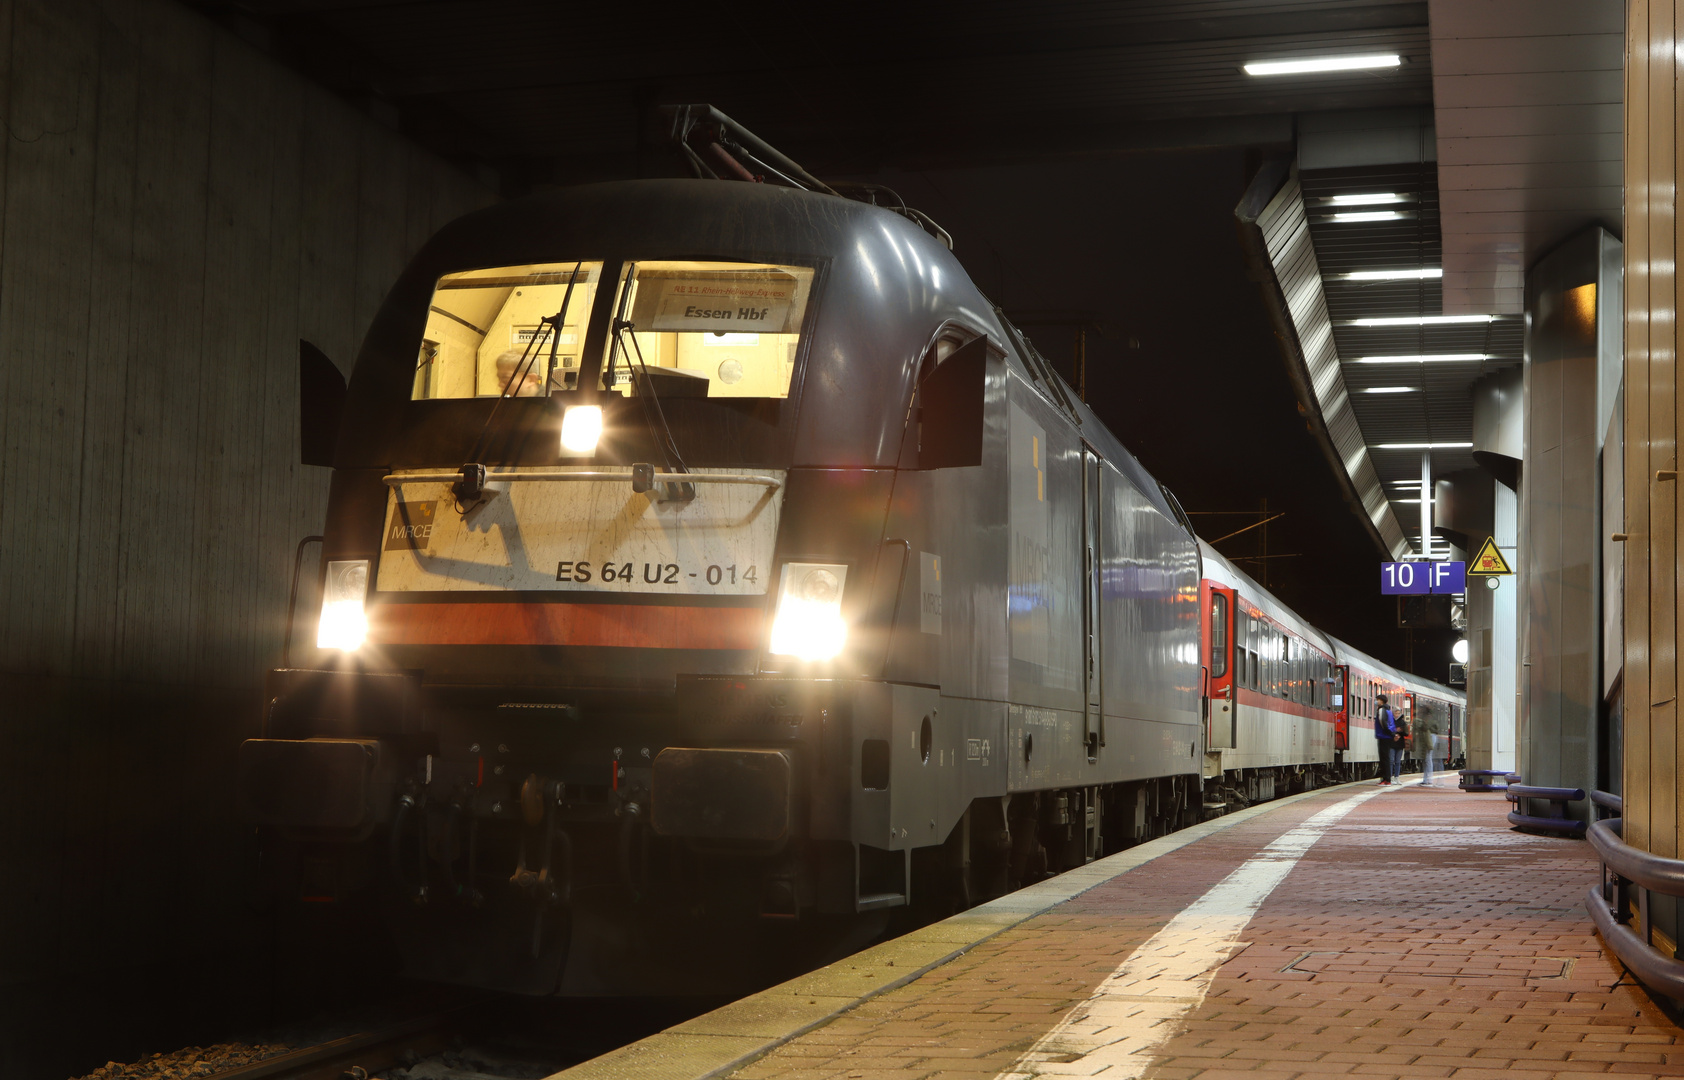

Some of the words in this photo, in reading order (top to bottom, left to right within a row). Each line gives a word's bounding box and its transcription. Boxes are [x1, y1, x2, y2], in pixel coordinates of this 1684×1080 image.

[687, 286, 699, 294] 11
[684, 305, 732, 320] Essen
[736, 307, 769, 321] Hbf
[391, 524, 432, 540] MRCE
[555, 561, 592, 583] ES
[600, 562, 634, 584] 64
[643, 563, 680, 585] U2
[705, 564, 758, 586] 014
[1385, 563, 1414, 588] 10
[1435, 562, 1451, 587] F
